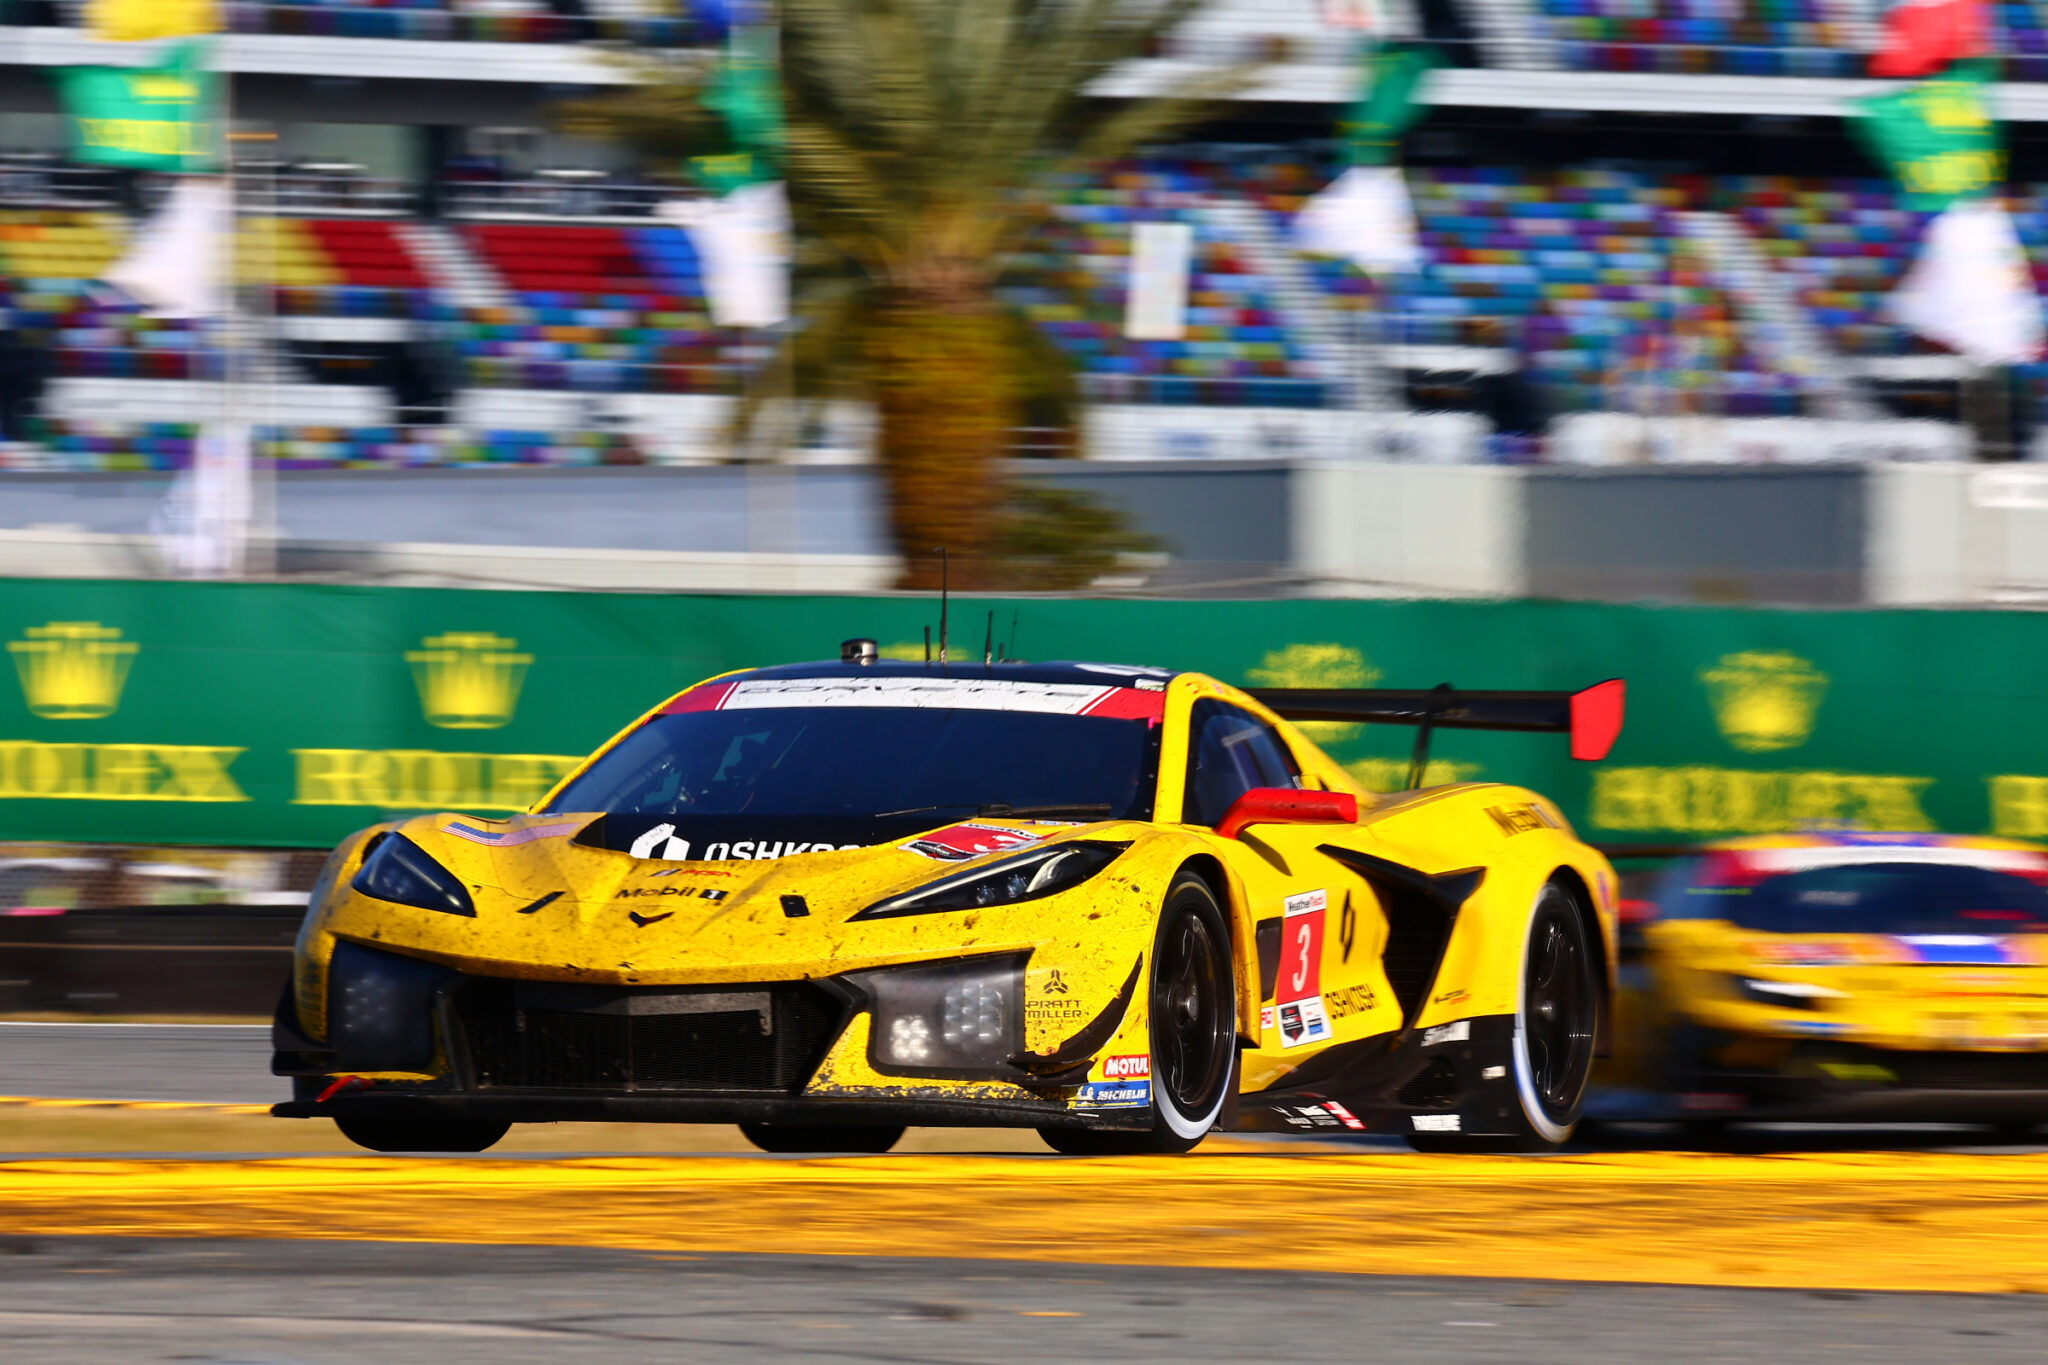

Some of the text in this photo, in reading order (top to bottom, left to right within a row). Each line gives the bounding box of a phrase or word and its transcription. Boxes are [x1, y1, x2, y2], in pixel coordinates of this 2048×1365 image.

[0, 740, 254, 802] OLEX
[290, 748, 590, 813] ROLE
[704, 841, 872, 862] OSHK
[615, 886, 697, 899] Mobil
[1292, 923, 1311, 992] 3
[1026, 1000, 1082, 1009] PRATT
[1027, 1009, 1082, 1019] MILLER
[1105, 1057, 1149, 1075] MOTUL
[1097, 1089, 1147, 1100] MICHELIN
